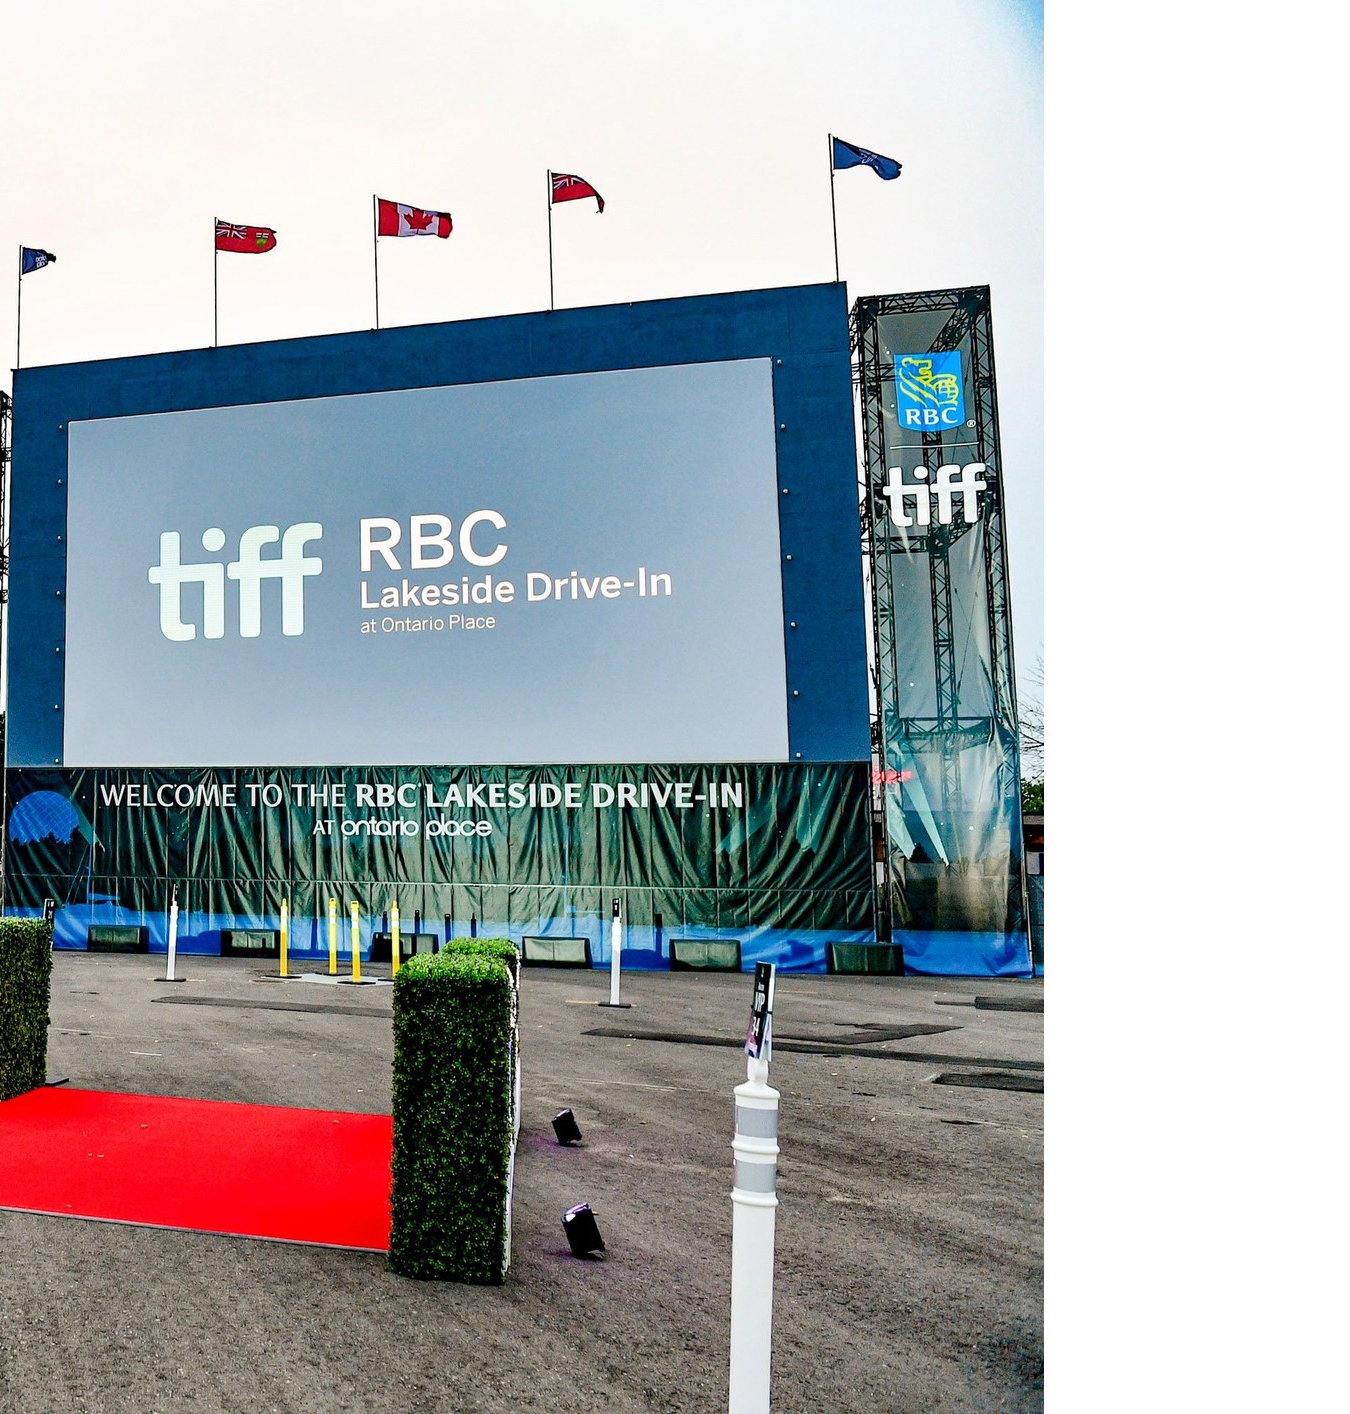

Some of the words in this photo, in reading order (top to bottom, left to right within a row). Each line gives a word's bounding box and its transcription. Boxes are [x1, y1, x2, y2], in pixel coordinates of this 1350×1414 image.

[905, 407, 958, 425] RBC
[883, 462, 987, 527] tiff
[360, 509, 508, 572] RBC
[148, 522, 323, 642] tiff
[361, 575, 515, 609] Lakeside
[527, 567, 672, 601] Drive-In
[360, 619, 377, 633] at
[381, 616, 444, 632] Ontario
[449, 614, 496, 630] Place
[100, 783, 237, 808] WELCOME
[245, 783, 282, 808] TO
[291, 783, 347, 808] THE
[356, 783, 418, 808] RBC
[426, 783, 583, 808] LAKESIDE
[592, 783, 743, 808] DRIVE-IN
[312, 820, 335, 836] AT
[341, 816, 420, 837] ontario
[425, 814, 493, 840] place
